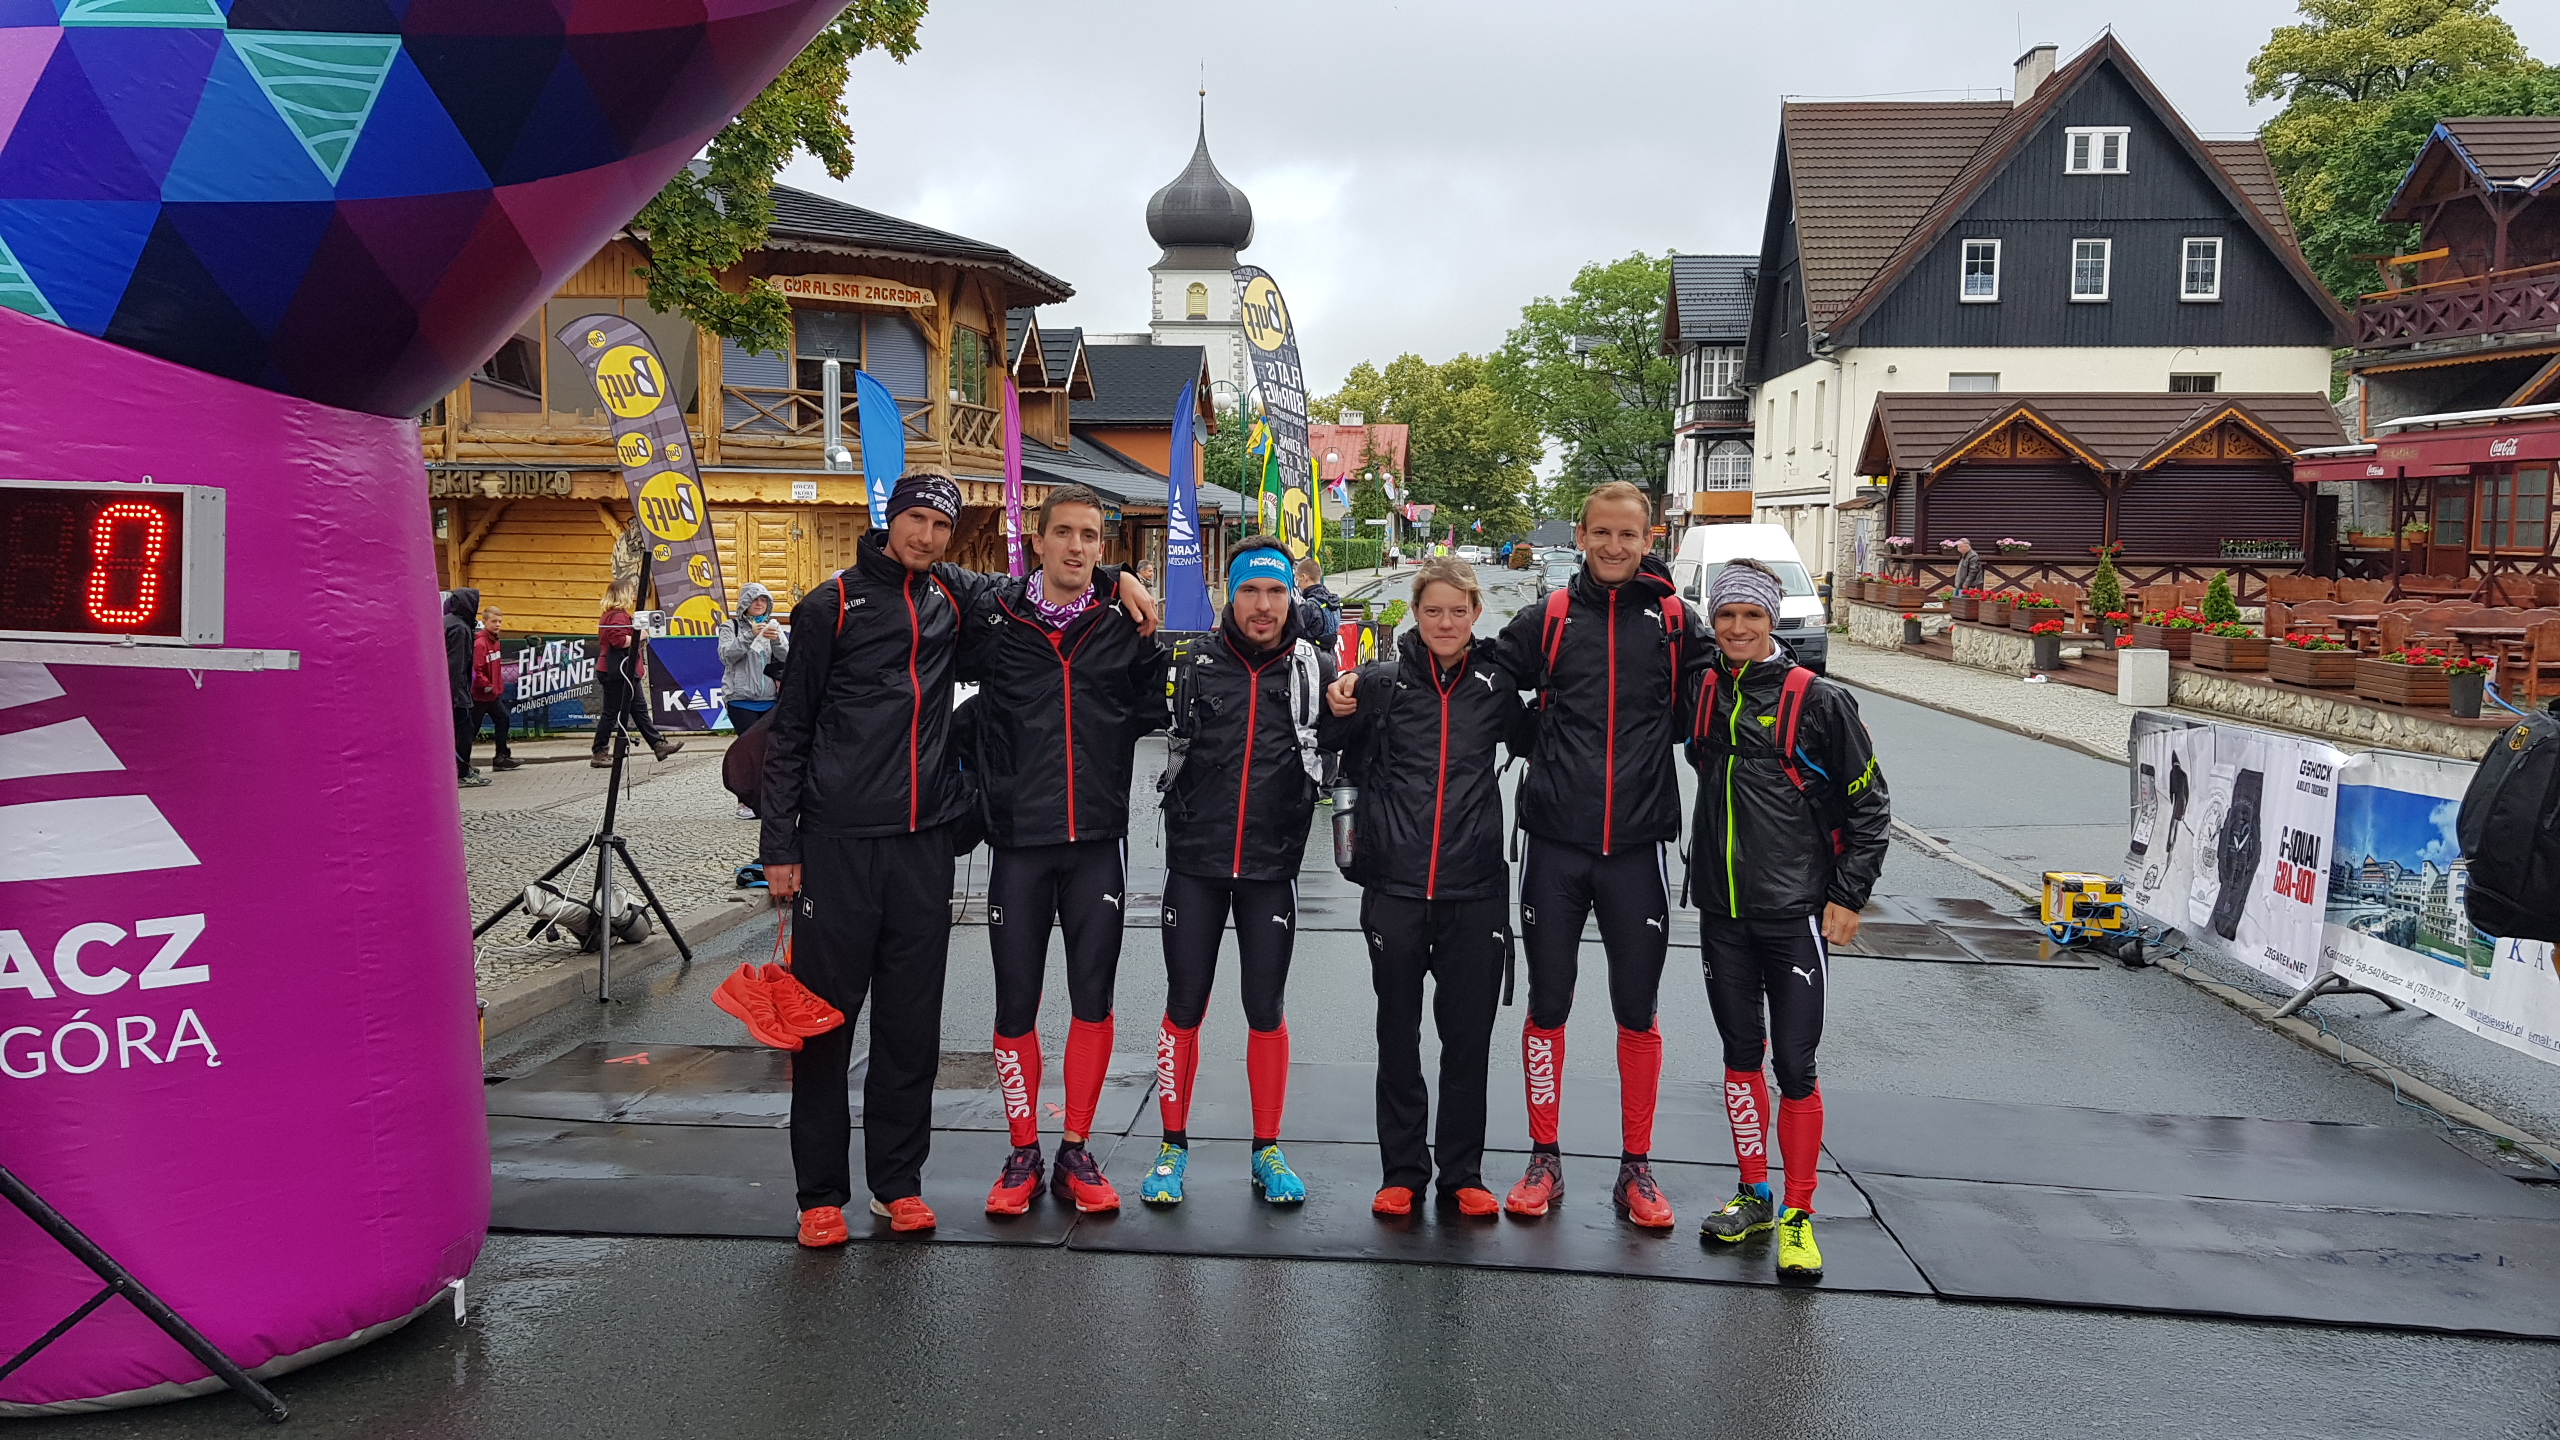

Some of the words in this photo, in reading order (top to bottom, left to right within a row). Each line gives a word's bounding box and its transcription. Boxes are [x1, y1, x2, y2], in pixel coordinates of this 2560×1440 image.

[88, 502, 165, 624] 0
[517, 658, 595, 700] BORING
[518, 640, 566, 674] FLAT
[568, 639, 585, 660] IS
[0, 1008, 222, 1079] GÓRĄ
[1157, 1027, 1177, 1102] suisse
[1528, 1035, 1555, 1105] suisse
[995, 1047, 1031, 1119] suisse
[1726, 1081, 1763, 1157] suisse
